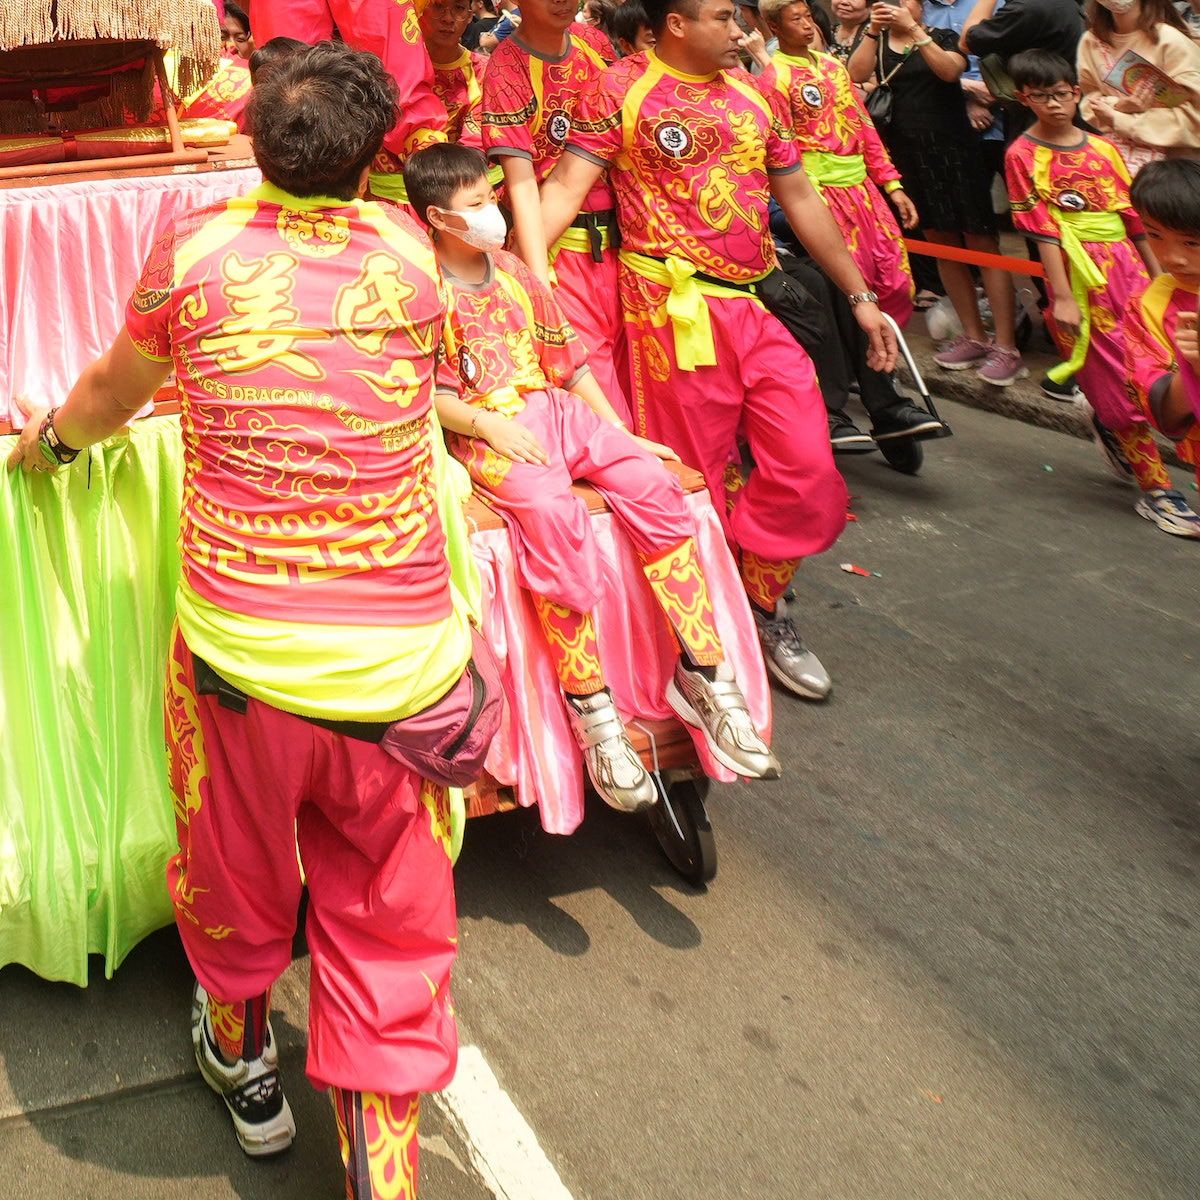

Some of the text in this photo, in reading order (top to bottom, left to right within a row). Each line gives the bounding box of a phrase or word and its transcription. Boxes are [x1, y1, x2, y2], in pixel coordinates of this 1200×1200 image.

[230, 385, 314, 406] DRAGON
[335, 402, 380, 436] LION
[381, 432, 422, 453] TEAM
